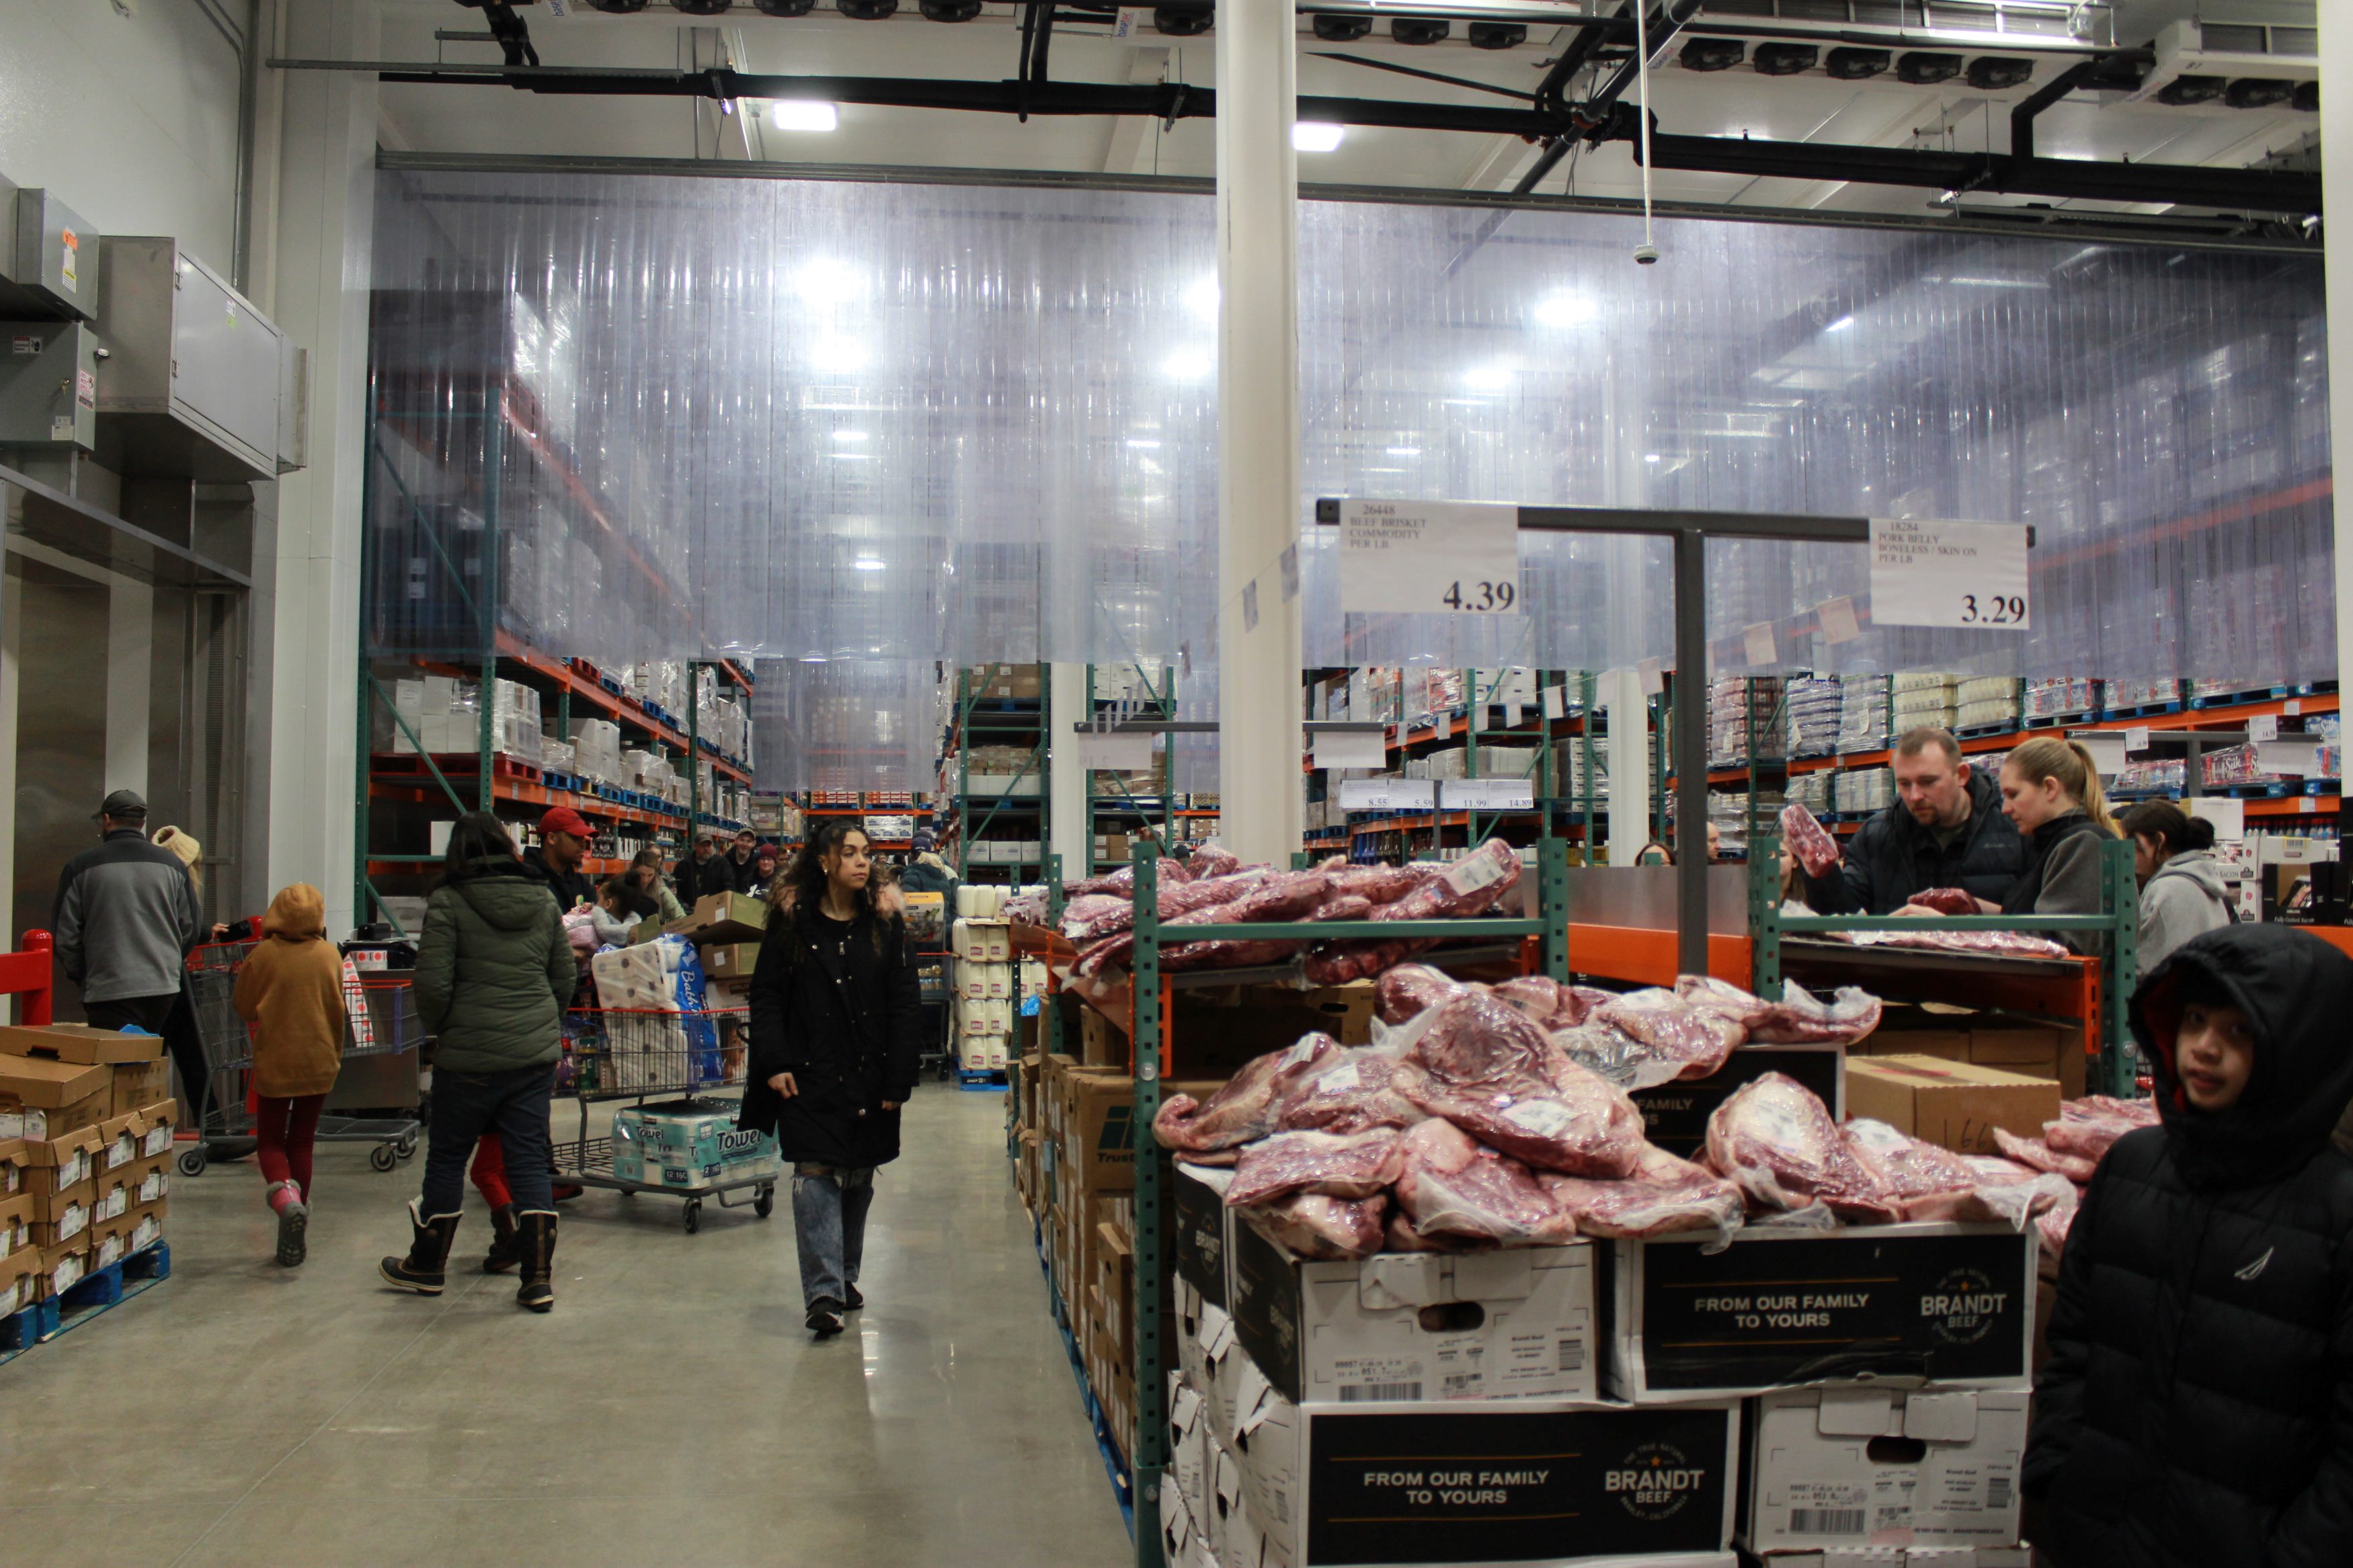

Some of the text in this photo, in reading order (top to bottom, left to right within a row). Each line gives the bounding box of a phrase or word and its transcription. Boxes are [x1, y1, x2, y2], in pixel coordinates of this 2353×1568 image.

[1363, 504, 1396, 515] 26448
[1350, 517, 1427, 528] BEEF BRISKET
[1890, 521, 1918, 532] 18284
[1349, 528, 1421, 538] COMMODITY
[1879, 532, 1940, 544] PORK BELLY
[1350, 539, 1371, 548] PER
[1879, 543, 1929, 554] BONELESS
[1938, 546, 1960, 555] SKIN
[1962, 547, 1977, 556] ON
[1878, 553, 1897, 563] PER
[1443, 581, 1515, 611] 4.39
[1962, 595, 2025, 624] 3.29
[2320, 718, 2336, 733] Silk
[2225, 755, 2241, 772] Silk
[1368, 798, 1388, 807] 8.55
[1414, 799, 1433, 807] 5.59
[1464, 799, 1487, 807] 11.99
[1509, 799, 1532, 807] 14.89
[681, 970, 699, 1008] Bath
[1637, 1097, 1693, 1110] FAMILY
[635, 1125, 664, 1140] Towel
[717, 1129, 763, 1152] Towel
[1694, 1293, 1870, 1313] FROM OUR FAMILY
[1920, 1293, 2008, 1317] BRANDT
[1735, 1313, 1831, 1329] TO YOURS
[1948, 1315, 1979, 1329] BEEF
[1364, 1470, 1550, 1487] FROM OUR FAMILY
[1605, 1469, 1706, 1492] BRANDT
[1406, 1490, 1507, 1505] TO YOURS
[1636, 1491, 1673, 1504] BEEF
